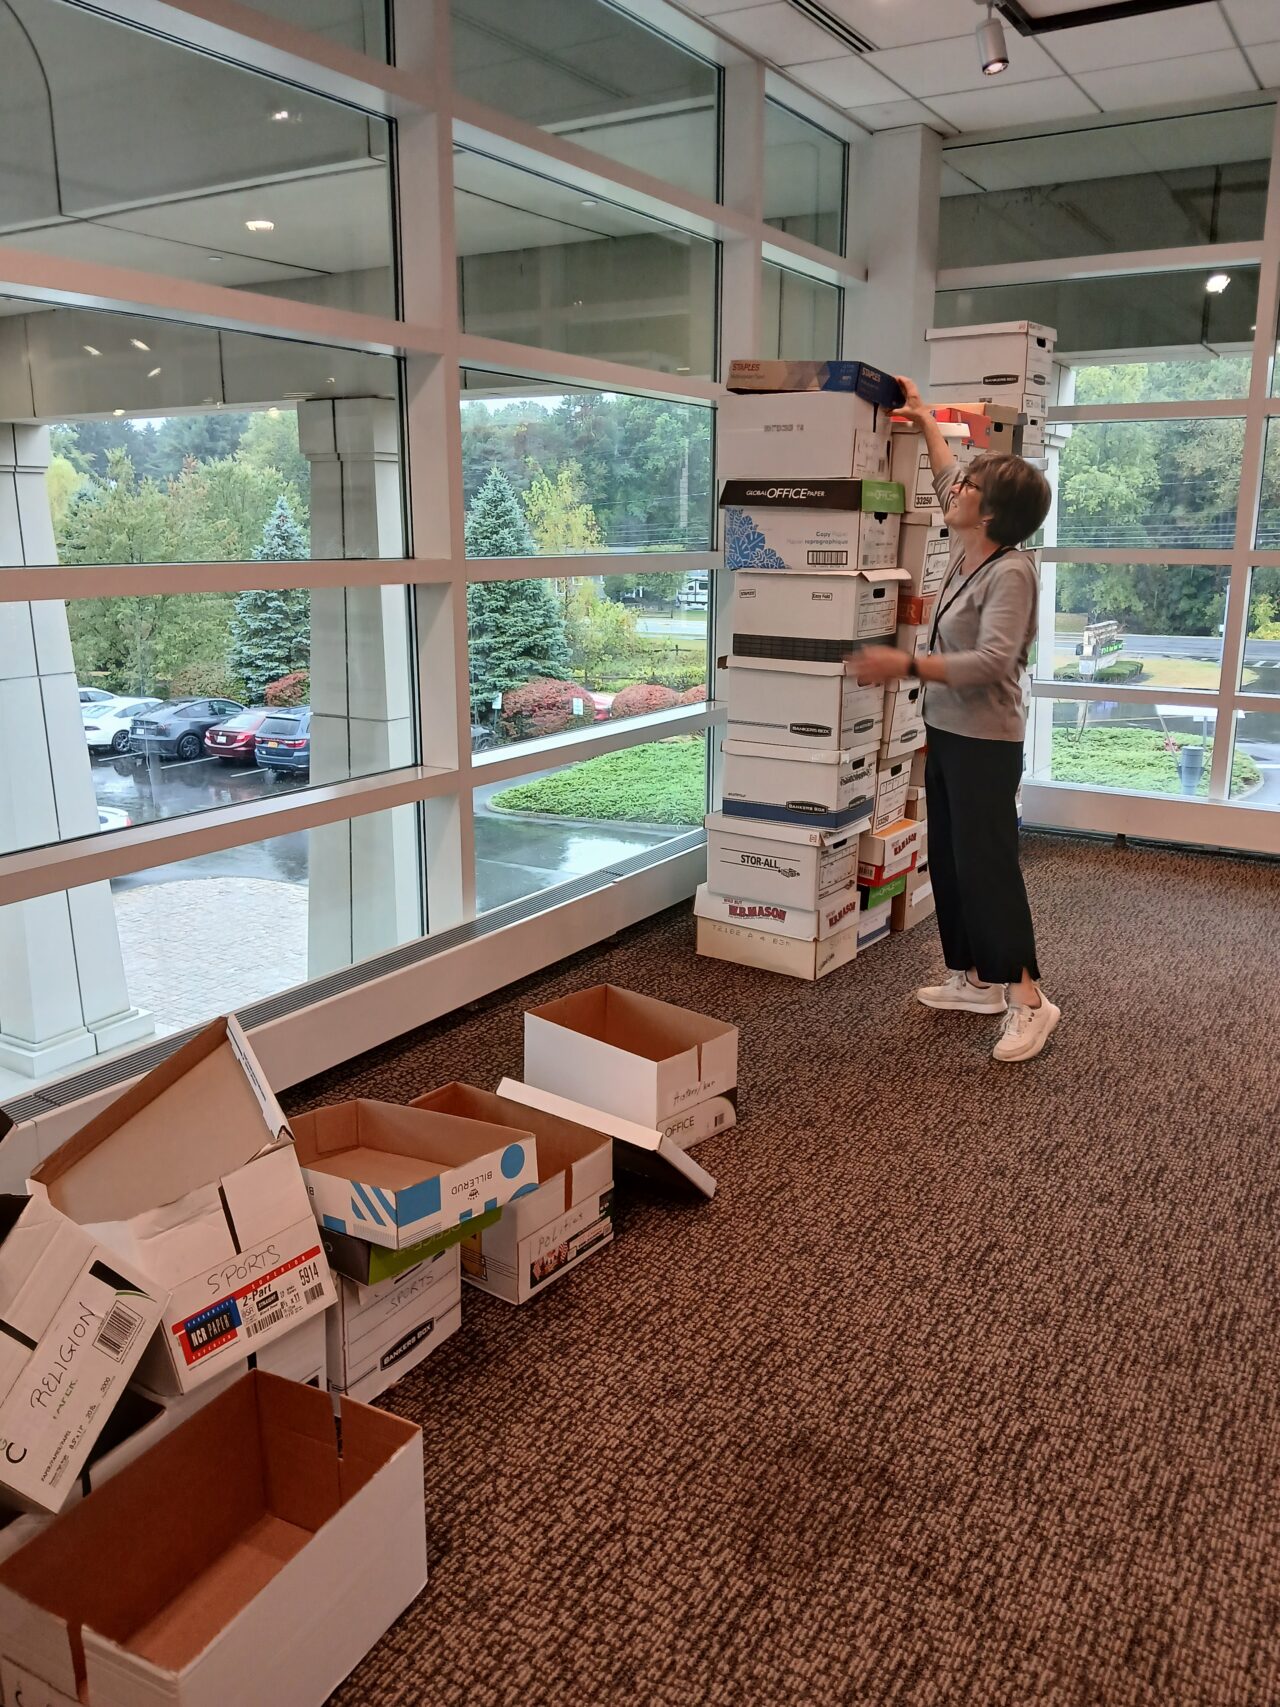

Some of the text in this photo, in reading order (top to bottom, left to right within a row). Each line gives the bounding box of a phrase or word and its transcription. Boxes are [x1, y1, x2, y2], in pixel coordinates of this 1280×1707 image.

[732, 363, 760, 371] STAPLES
[767, 488, 808, 499] OFFICE
[740, 854, 779, 869] STOR-ALL
[664, 1115, 695, 1138] OFFICE
[451, 1170, 493, 1195] BILLERUD
[207, 1244, 281, 1295] SPORTS
[299, 1262, 320, 1287] 5914
[242, 1283, 272, 1307] 2-Part
[389, 1271, 434, 1308] SPORTS
[191, 1314, 231, 1348] NCR PAPER
[30, 1301, 96, 1409] RELIGION
[384, 1323, 432, 1365] BANKERS BOX
[99, 1376, 111, 1392] 5000
